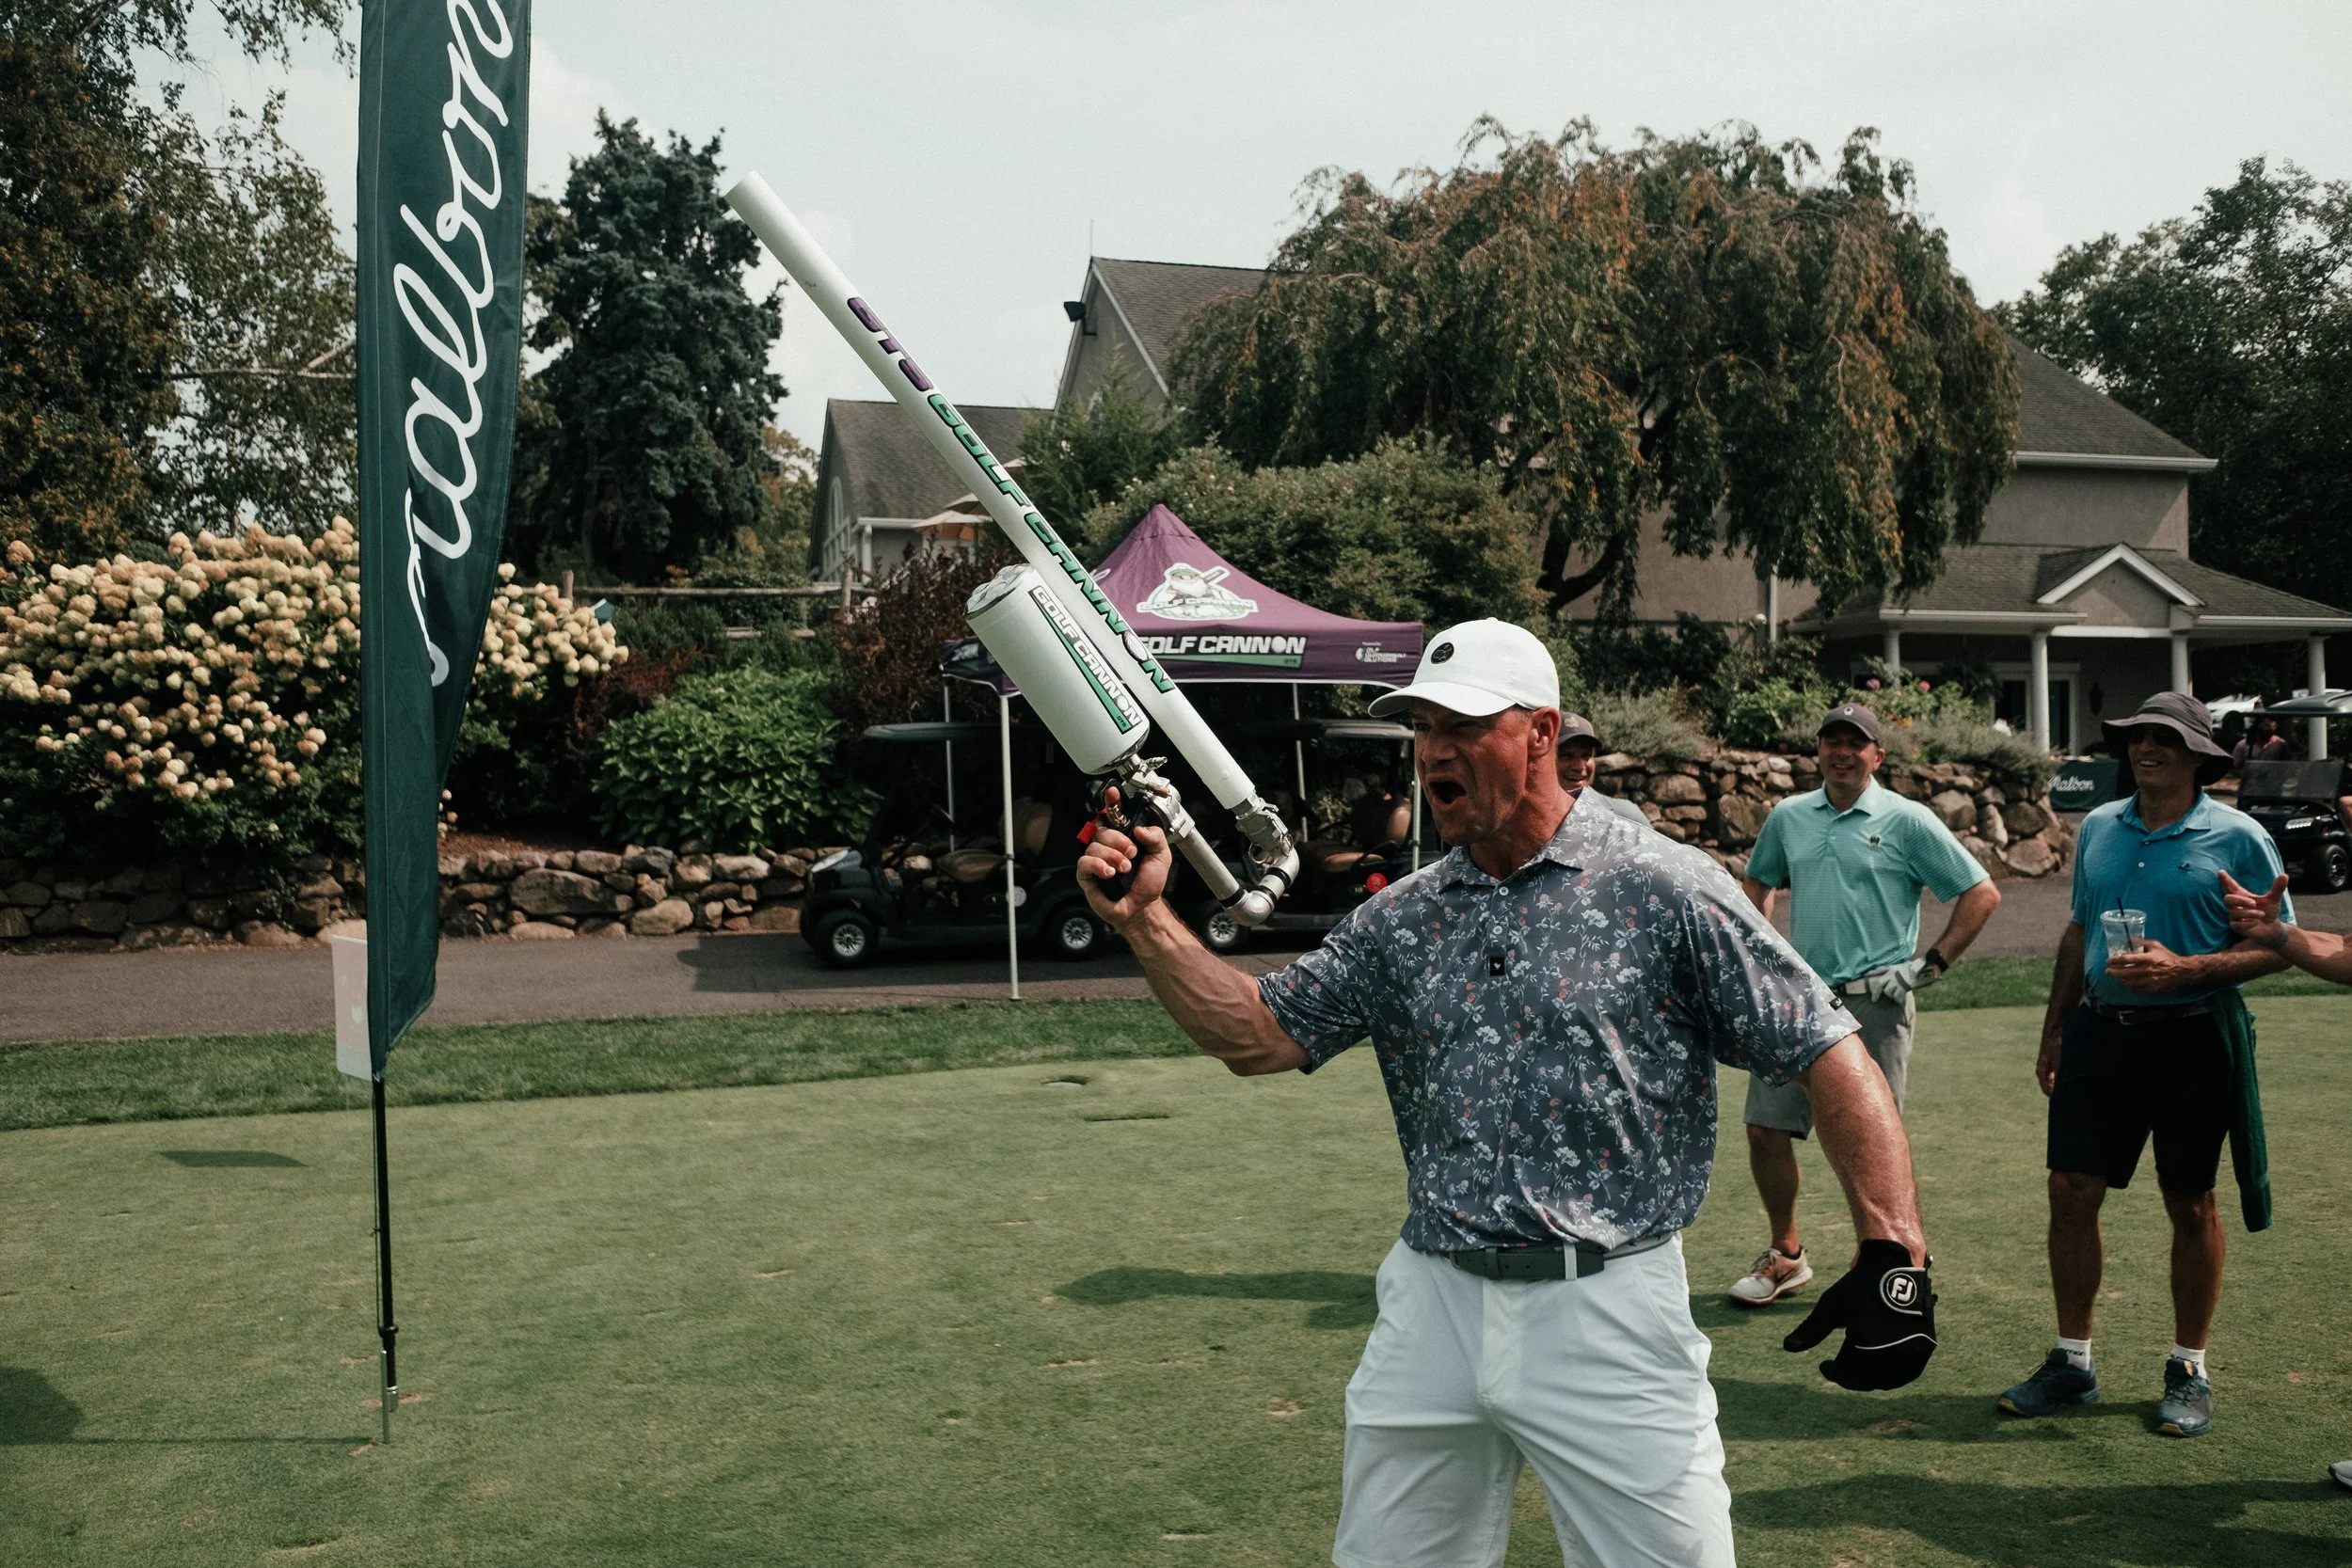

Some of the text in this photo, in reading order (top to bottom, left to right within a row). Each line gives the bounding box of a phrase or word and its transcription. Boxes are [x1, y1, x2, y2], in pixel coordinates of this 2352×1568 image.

[928, 393, 1031, 507] GOLF
[1024, 512, 1176, 694] CANNON
[1033, 585, 1142, 725] GOLF CANNON
[1199, 636, 1306, 654] CANNON
[2047, 775, 2095, 792] Malbon
[1891, 1277, 1914, 1302] FJ
